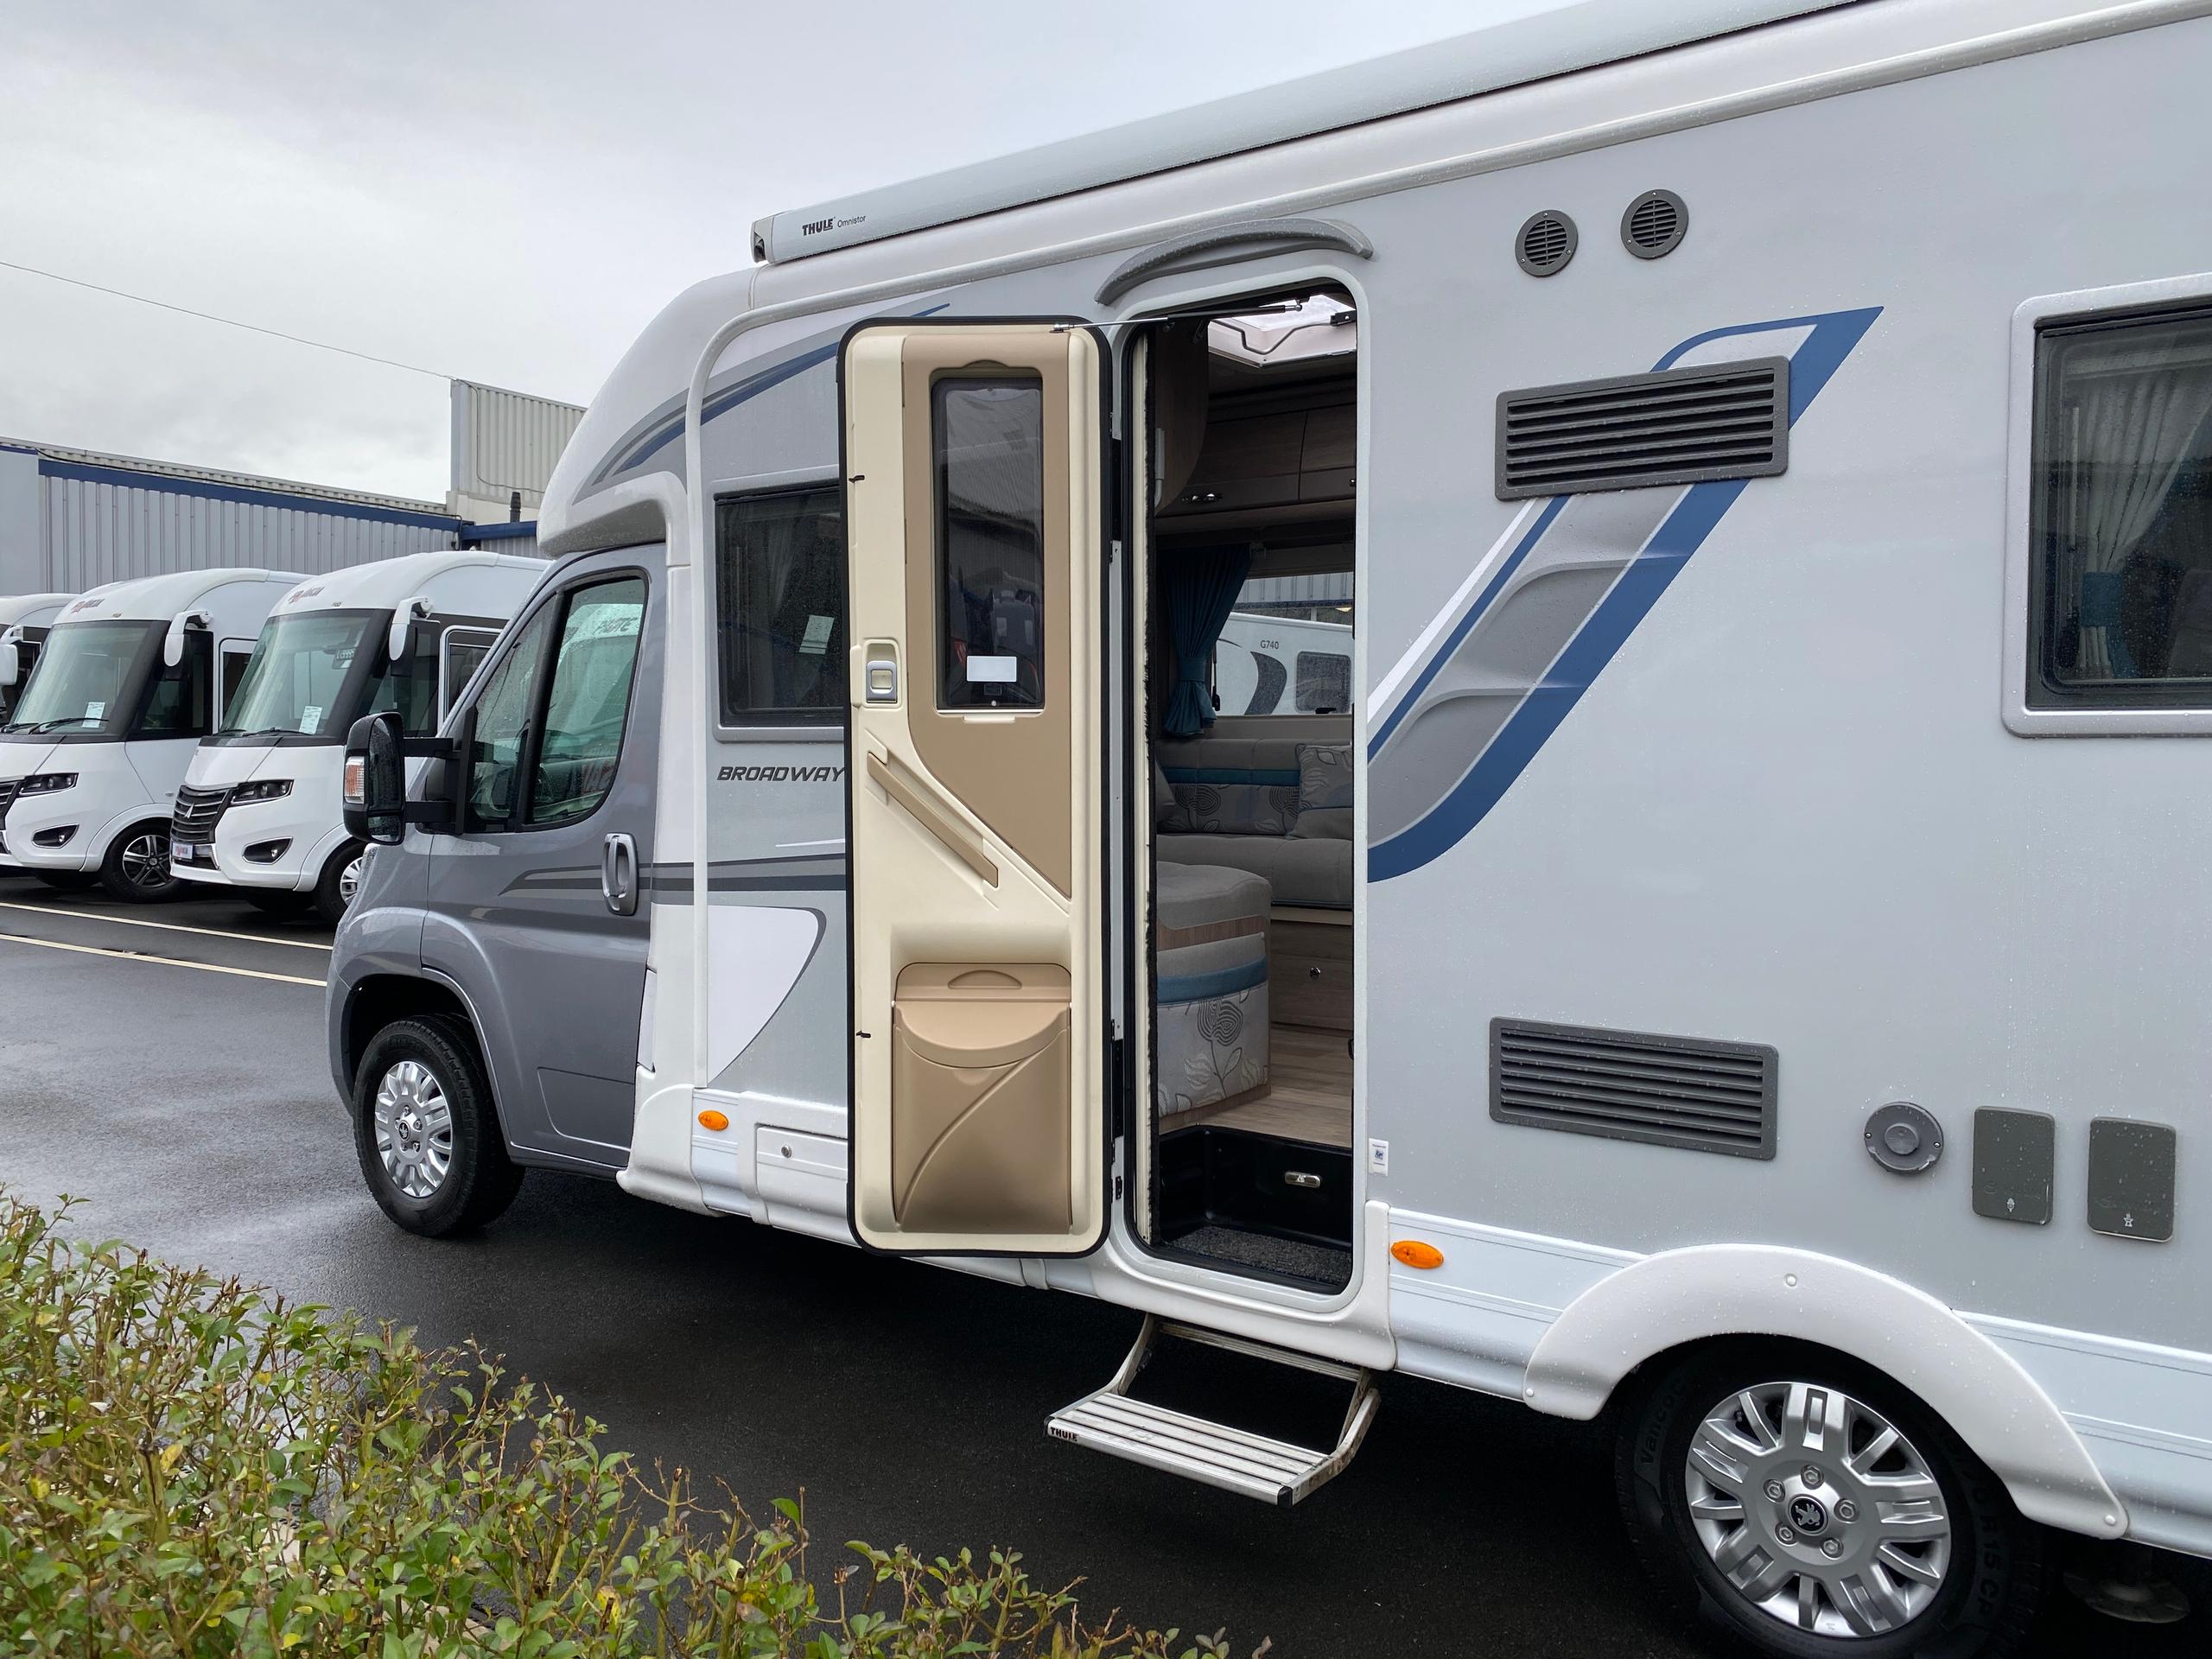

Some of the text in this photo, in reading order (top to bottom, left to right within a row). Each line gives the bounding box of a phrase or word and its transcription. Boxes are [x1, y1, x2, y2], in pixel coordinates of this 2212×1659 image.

[802, 215, 867, 236] THULE Omnistor
[1260, 639, 1280, 650] G740
[717, 766, 844, 782] BROADWAY
[1050, 1427, 1077, 1442] THULE
